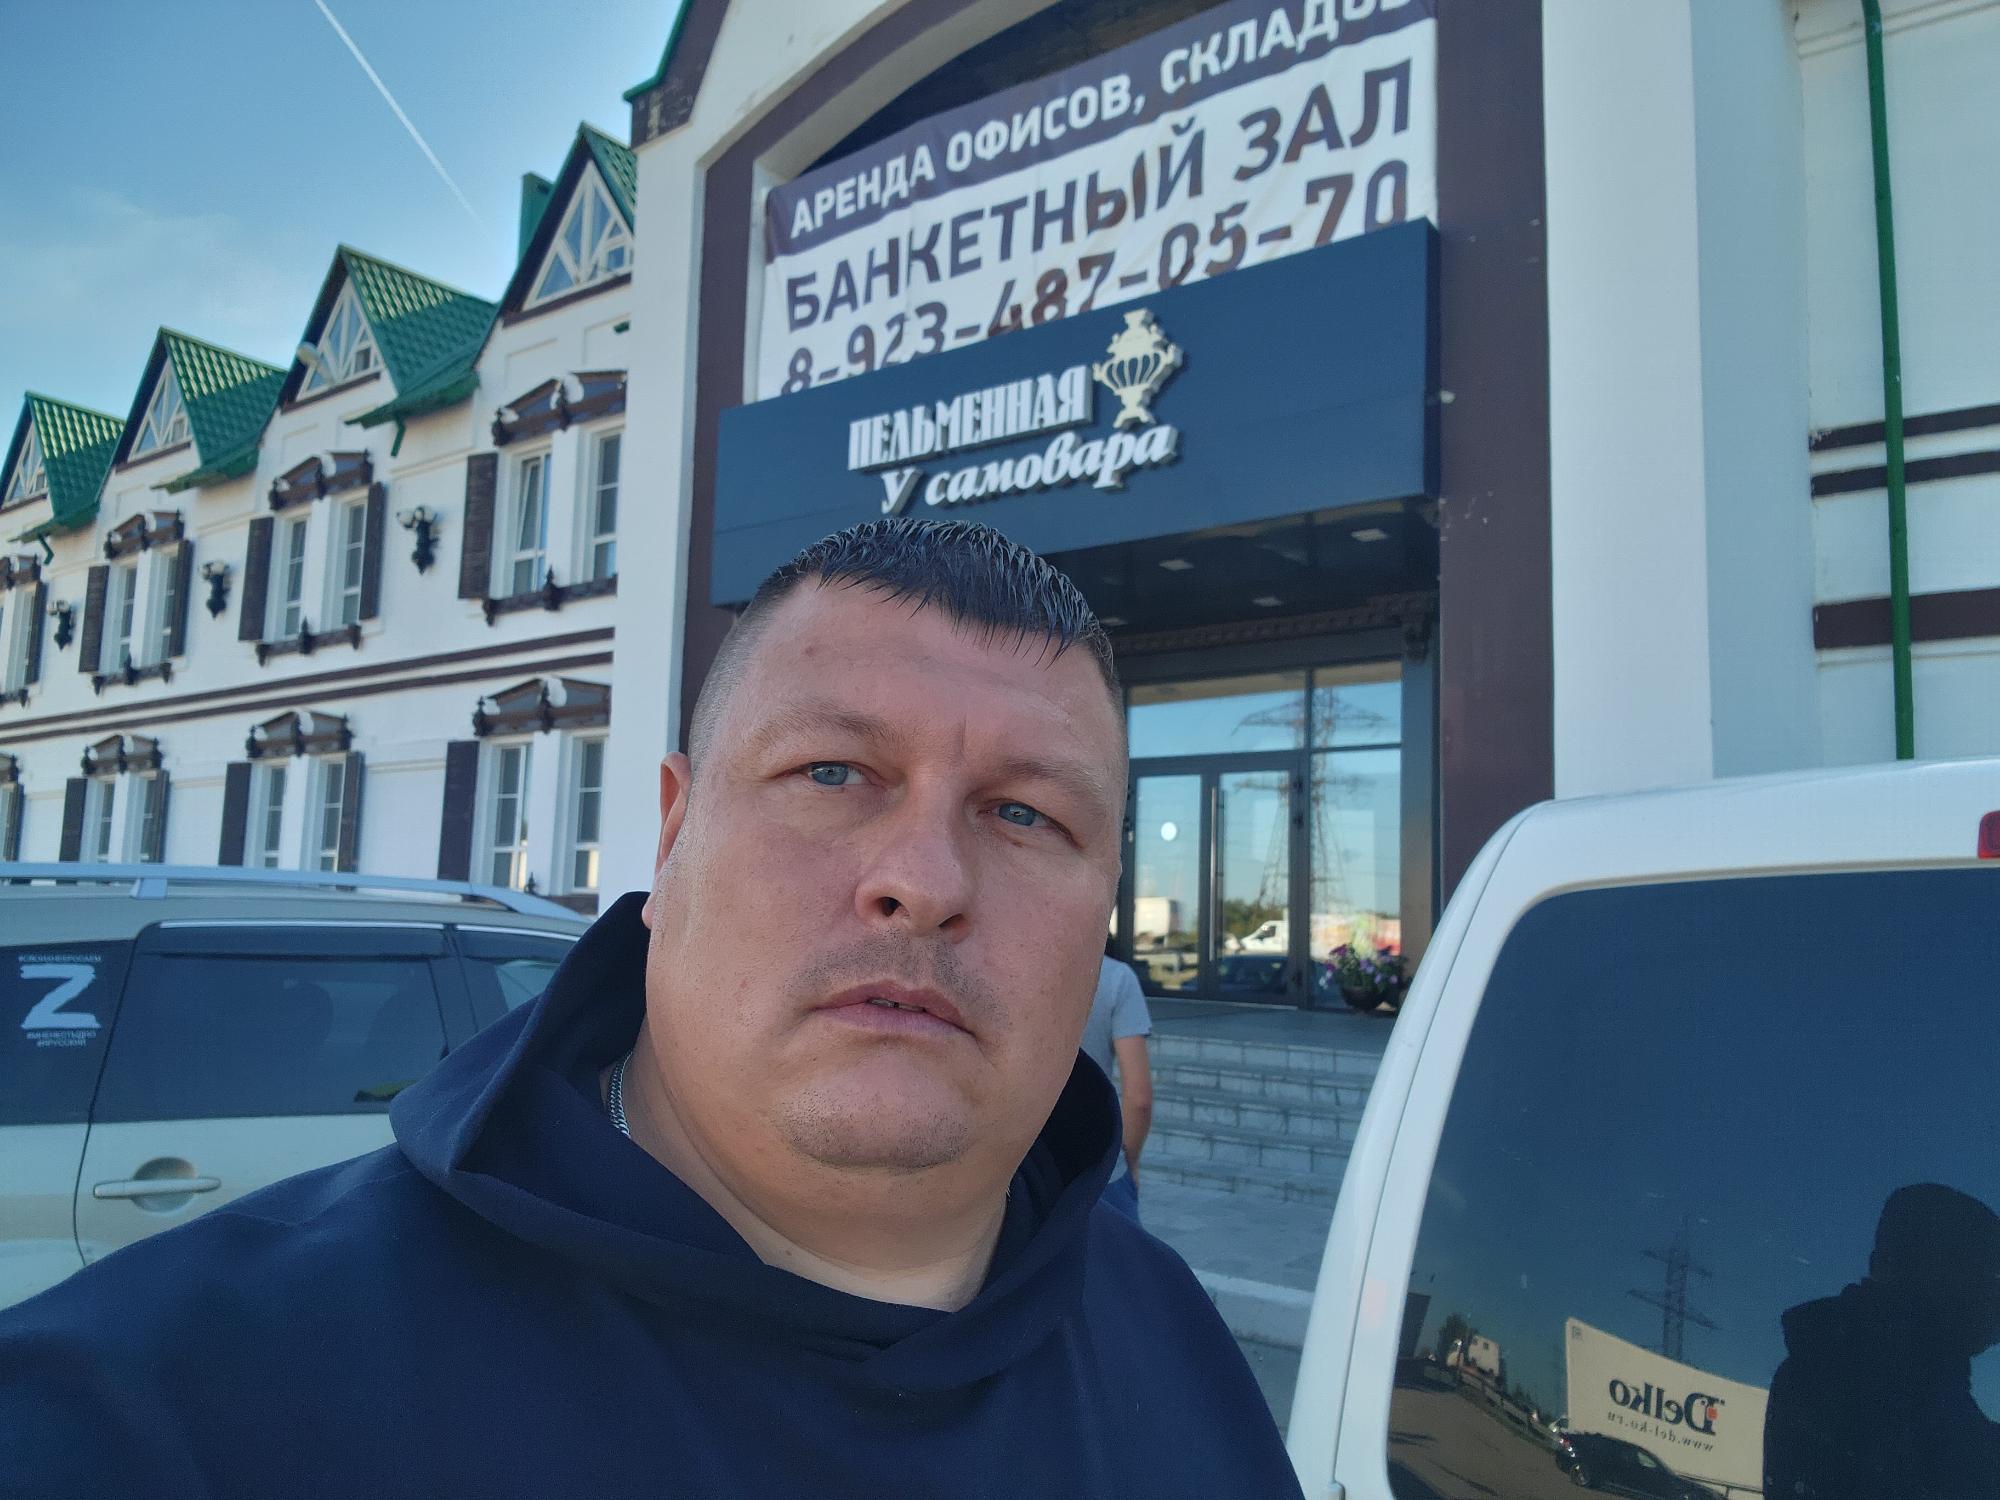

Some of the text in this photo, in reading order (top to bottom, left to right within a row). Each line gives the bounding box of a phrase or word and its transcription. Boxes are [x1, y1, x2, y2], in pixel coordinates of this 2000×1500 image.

[786, 56, 1412, 333] БАНКЕТНЫЙ ЗАЛ
[790, 0, 1411, 239] АРЕНДА ОФИСОВ, СКЛАД
[781, 158, 1408, 394] 8-923-487-05-70
[847, 364, 1091, 471] ПЕЛЬМЕННАЯ
[880, 425, 1177, 514] У самовара
[20, 964, 101, 1029] Z
